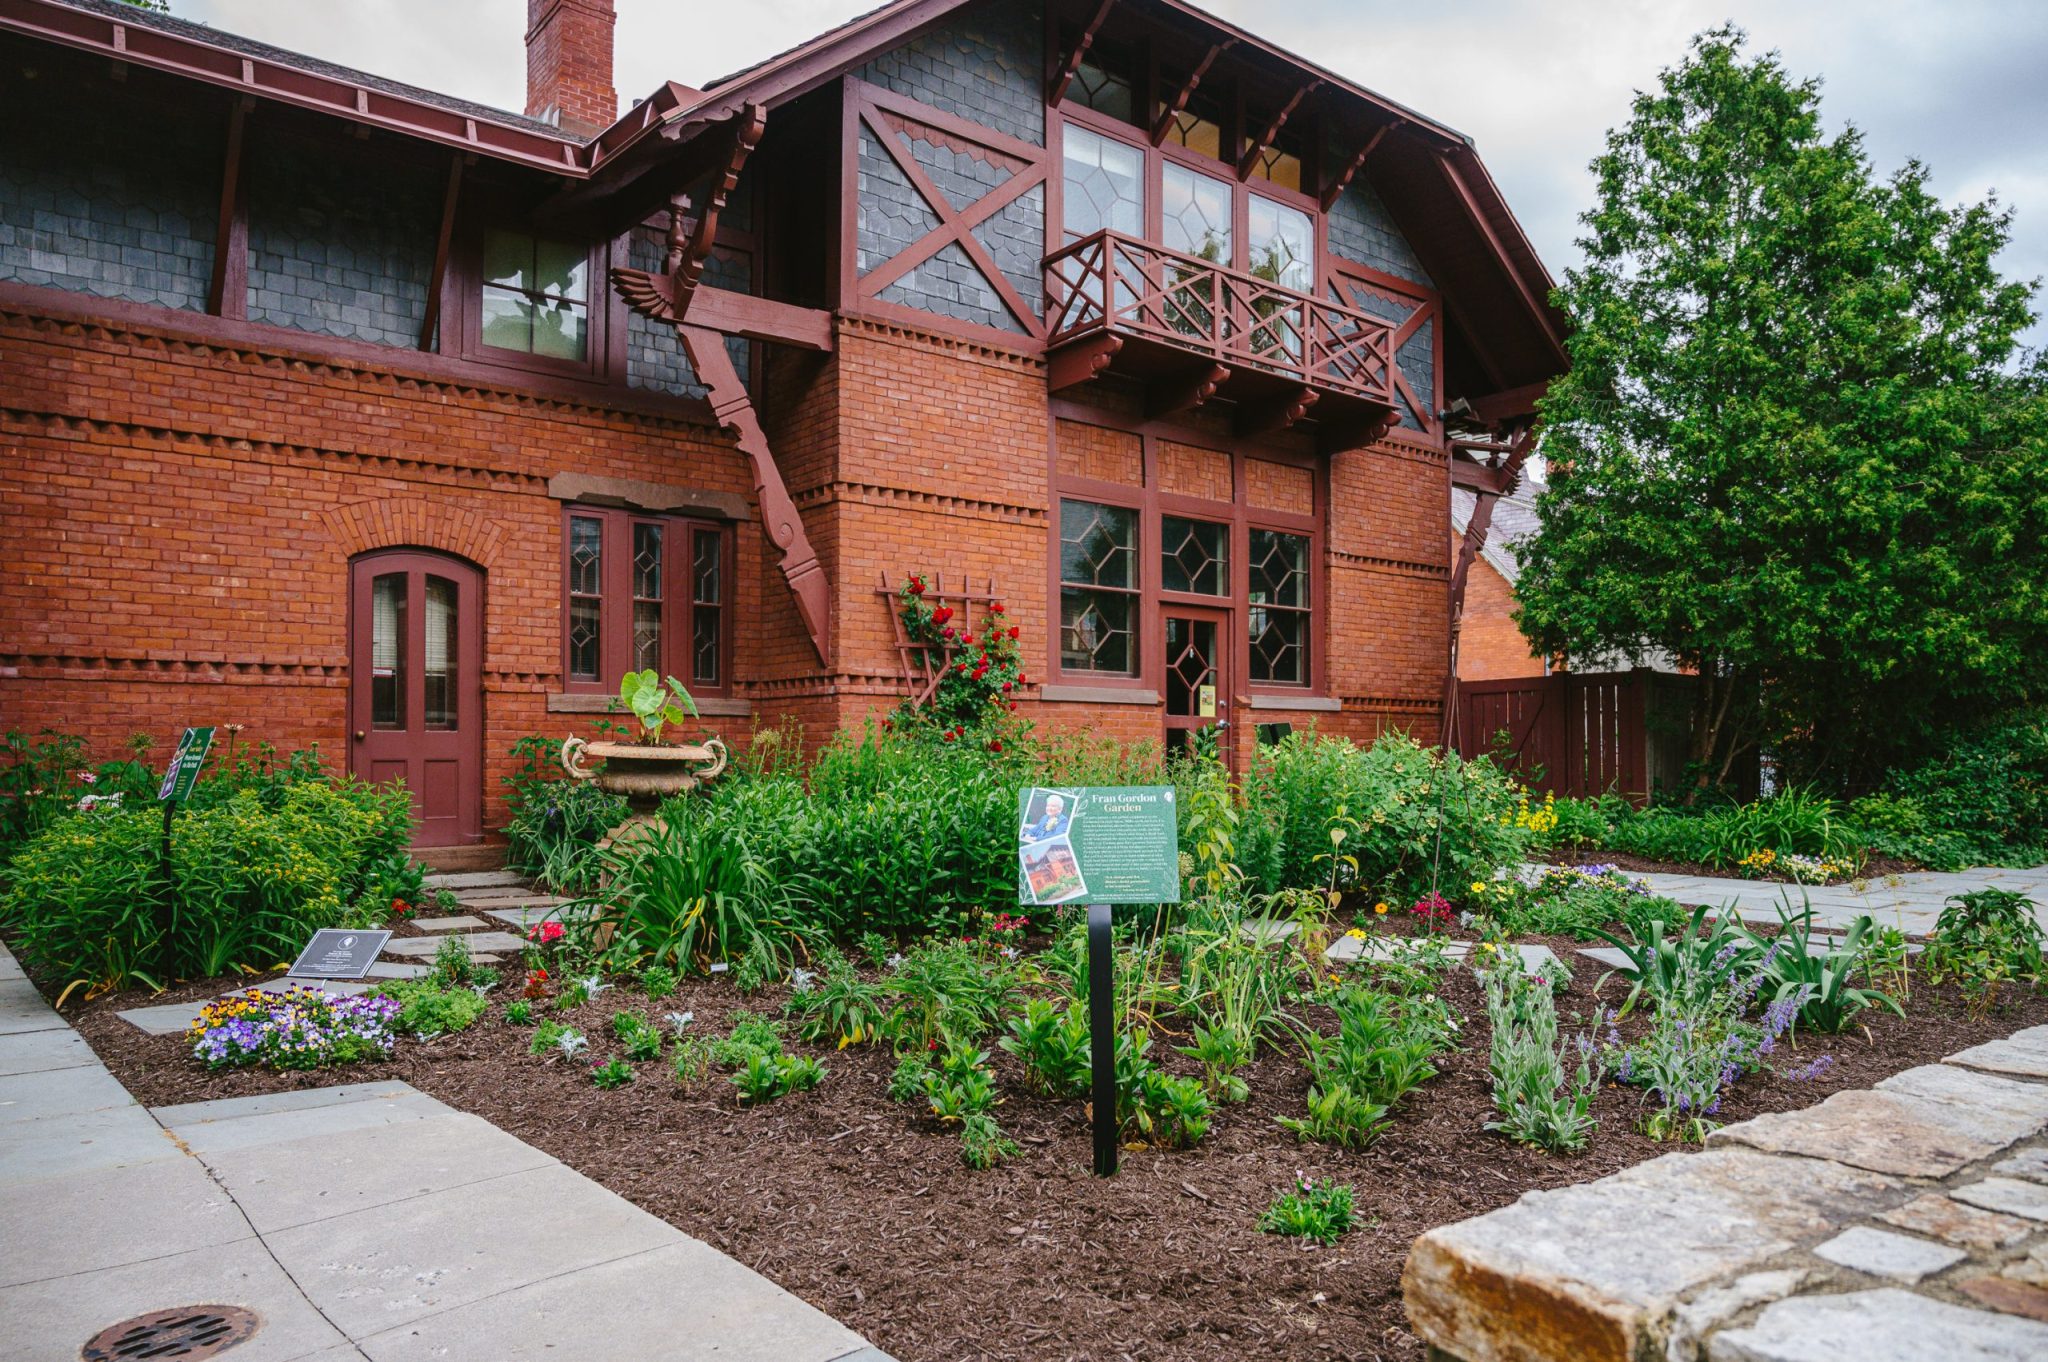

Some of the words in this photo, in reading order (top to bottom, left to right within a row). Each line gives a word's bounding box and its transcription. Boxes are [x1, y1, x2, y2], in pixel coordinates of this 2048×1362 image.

[1092, 794, 1116, 803] Fran
[1117, 793, 1157, 803] Gordon
[1103, 803, 1142, 812] Garden
